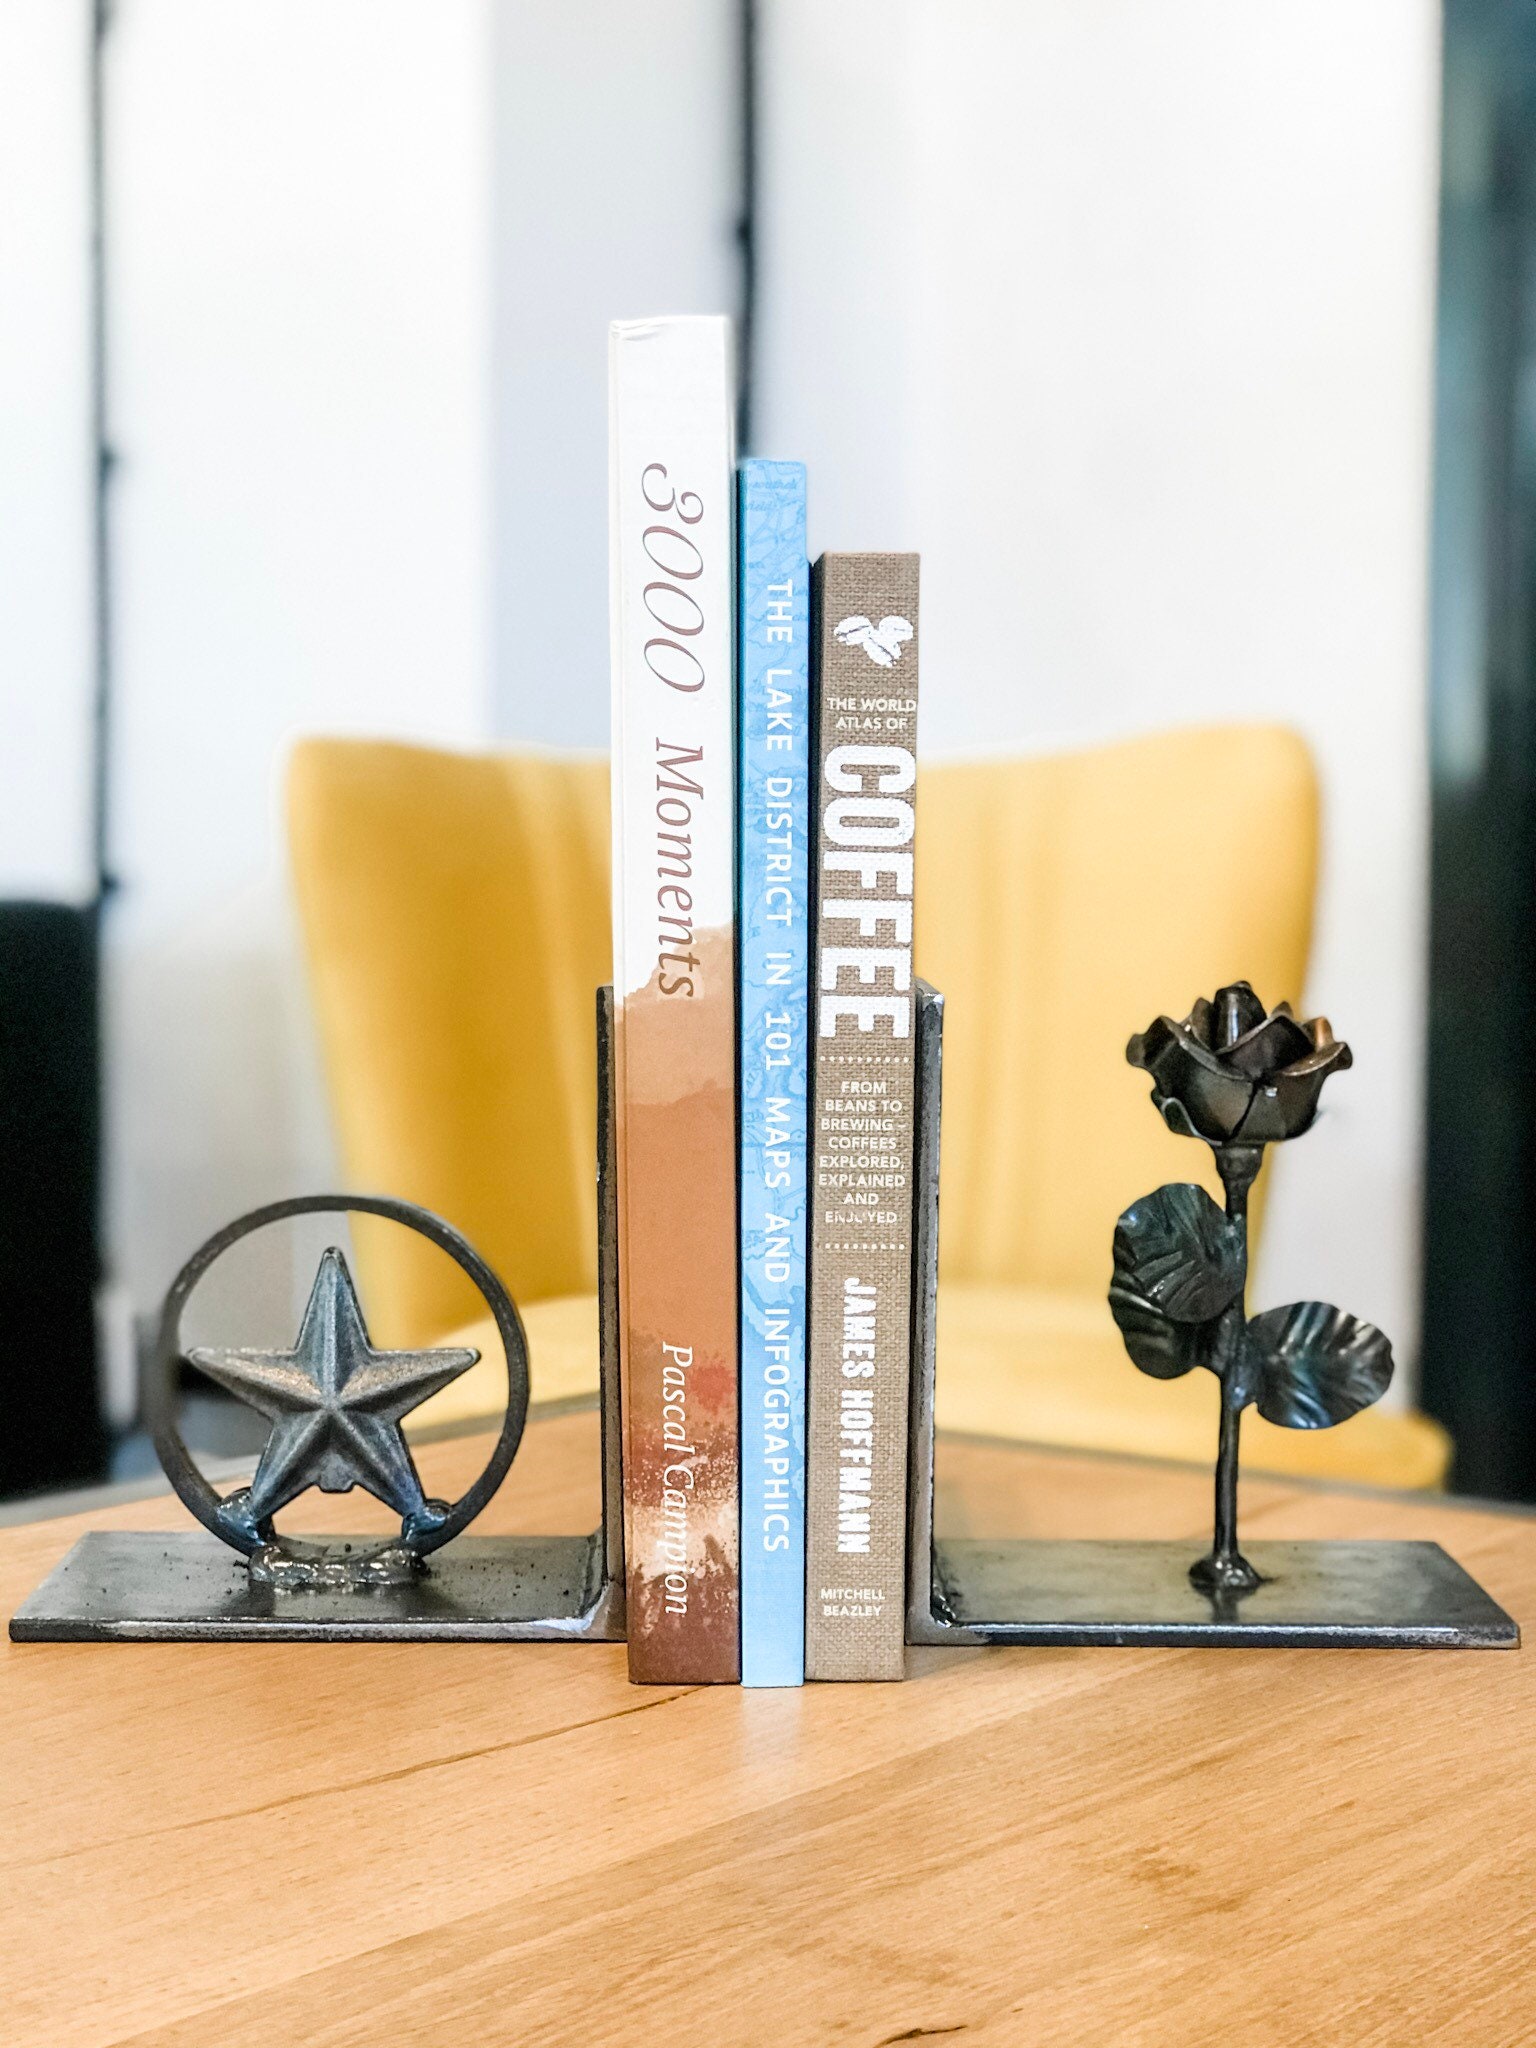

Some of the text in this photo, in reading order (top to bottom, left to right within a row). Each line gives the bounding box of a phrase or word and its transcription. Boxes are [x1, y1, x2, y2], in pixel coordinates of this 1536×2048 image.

[826, 697, 917, 713] THE WORLD
[641, 462, 706, 998] 3000 Moments
[835, 716, 908, 731] ATLAS OF
[818, 744, 917, 1039] COFFEE
[763, 578, 793, 1552] THE LAKE DISTRICT IN 101 MAPS AND INFOGRAPHICS
[840, 1080, 887, 1095] FROM
[825, 1099, 903, 1113] BEANS TO
[820, 1117, 894, 1132] BREWING
[828, 1136, 898, 1151] COFFEES
[819, 1155, 905, 1170] EXPLORED,
[818, 1173, 906, 1188] EXPLAINED
[841, 1192, 880, 1206] AND
[837, 1277, 877, 1553] JAMES HOFFMANN
[656, 1341, 697, 1616] Pascal Campion
[820, 1588, 886, 1601] MITCHELL
[823, 1604, 882, 1617] BEAZLEY
